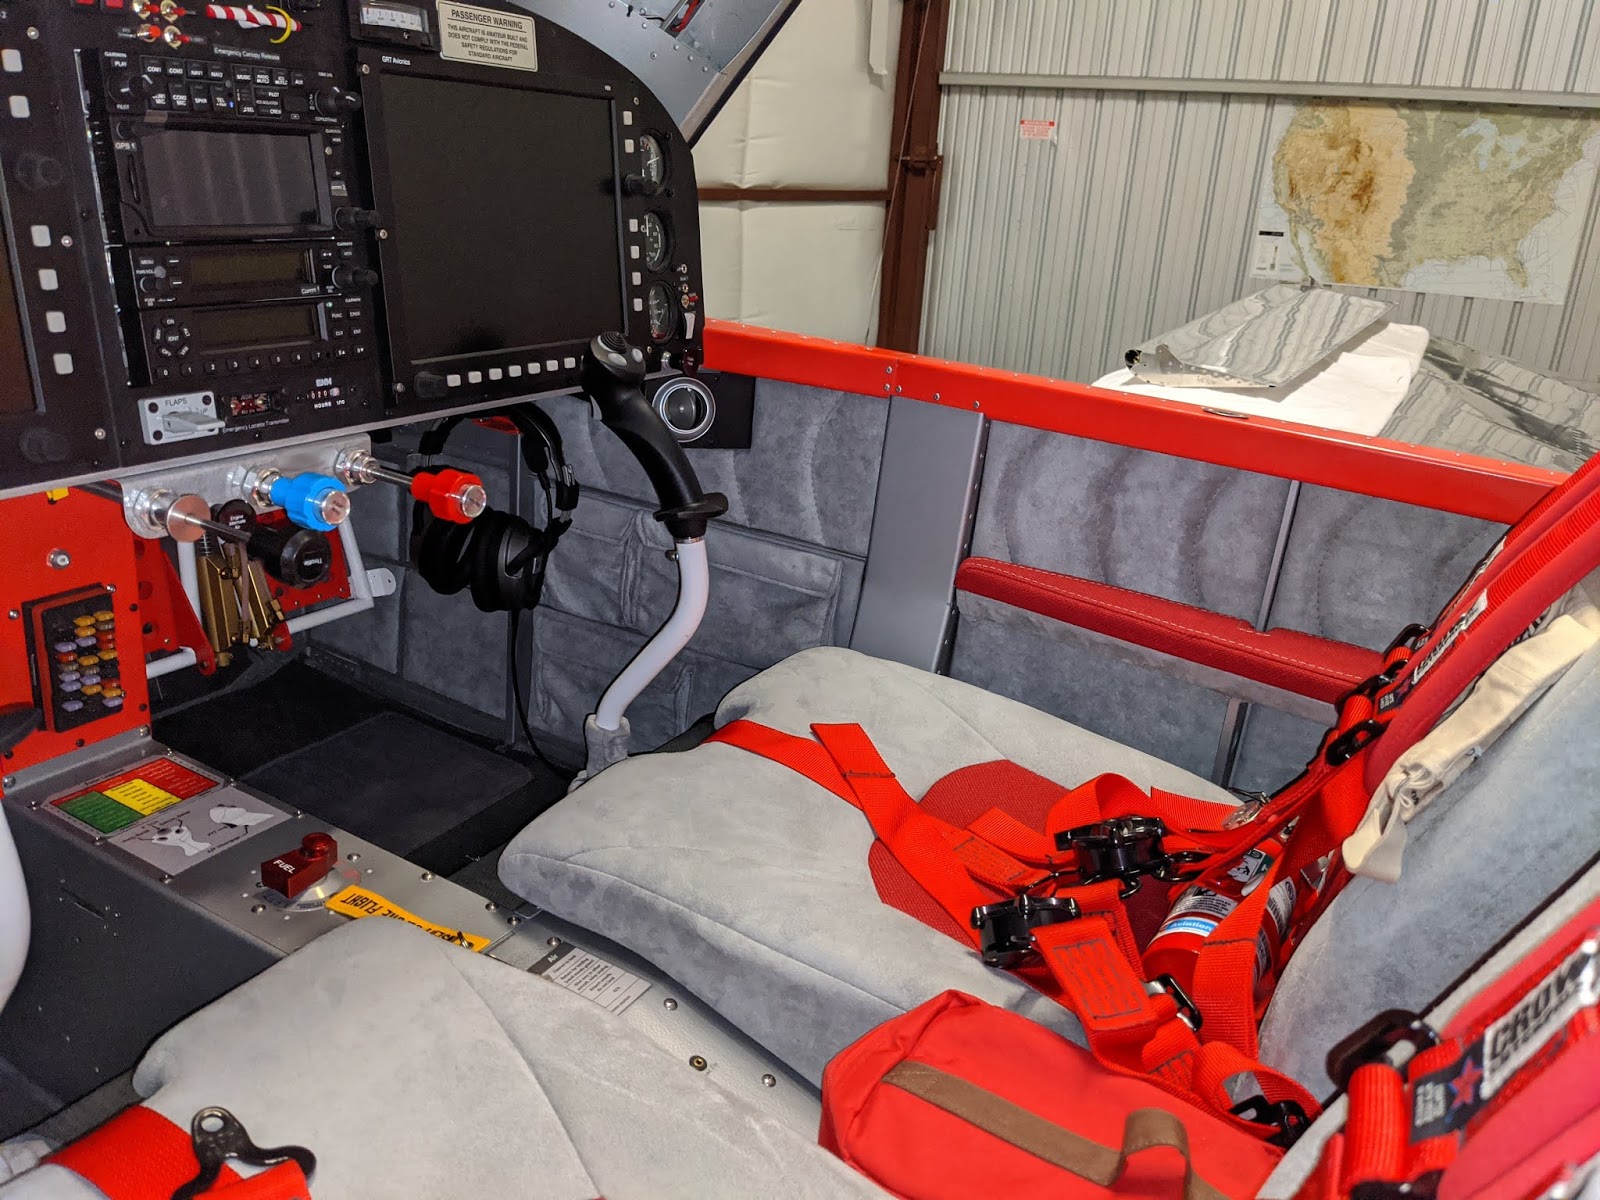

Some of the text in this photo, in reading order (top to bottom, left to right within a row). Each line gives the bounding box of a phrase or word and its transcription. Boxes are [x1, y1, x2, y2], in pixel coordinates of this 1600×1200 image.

[451, 9, 523, 30] PASSENGER WARNING
[458, 26, 481, 34] AIRCRAFT
[486, 30, 507, 39] AMATEUR
[507, 33, 518, 41] BUILT
[448, 32, 461, 40] DOES
[471, 36, 489, 44] COMPLY
[490, 38, 501, 46] WITH
[510, 42, 528, 50] FEDERAL
[214, 47, 280, 60] Emergency Canopy Release
[462, 42, 478, 50] SAFETY
[478, 44, 508, 54] REGULATIONS
[381, 55, 411, 66] GRT Avionics
[468, 50, 512, 62] STANDARD AIRCRAFT
[115, 142, 131, 150] GPS
[165, 398, 188, 407] FLAPS
[222, 425, 248, 434] Emergency
[273, 859, 296, 874] FUEL
[340, 893, 383, 915] FLIGHT
[1170, 919, 1213, 932] Aviation
[547, 954, 559, 963] Air
